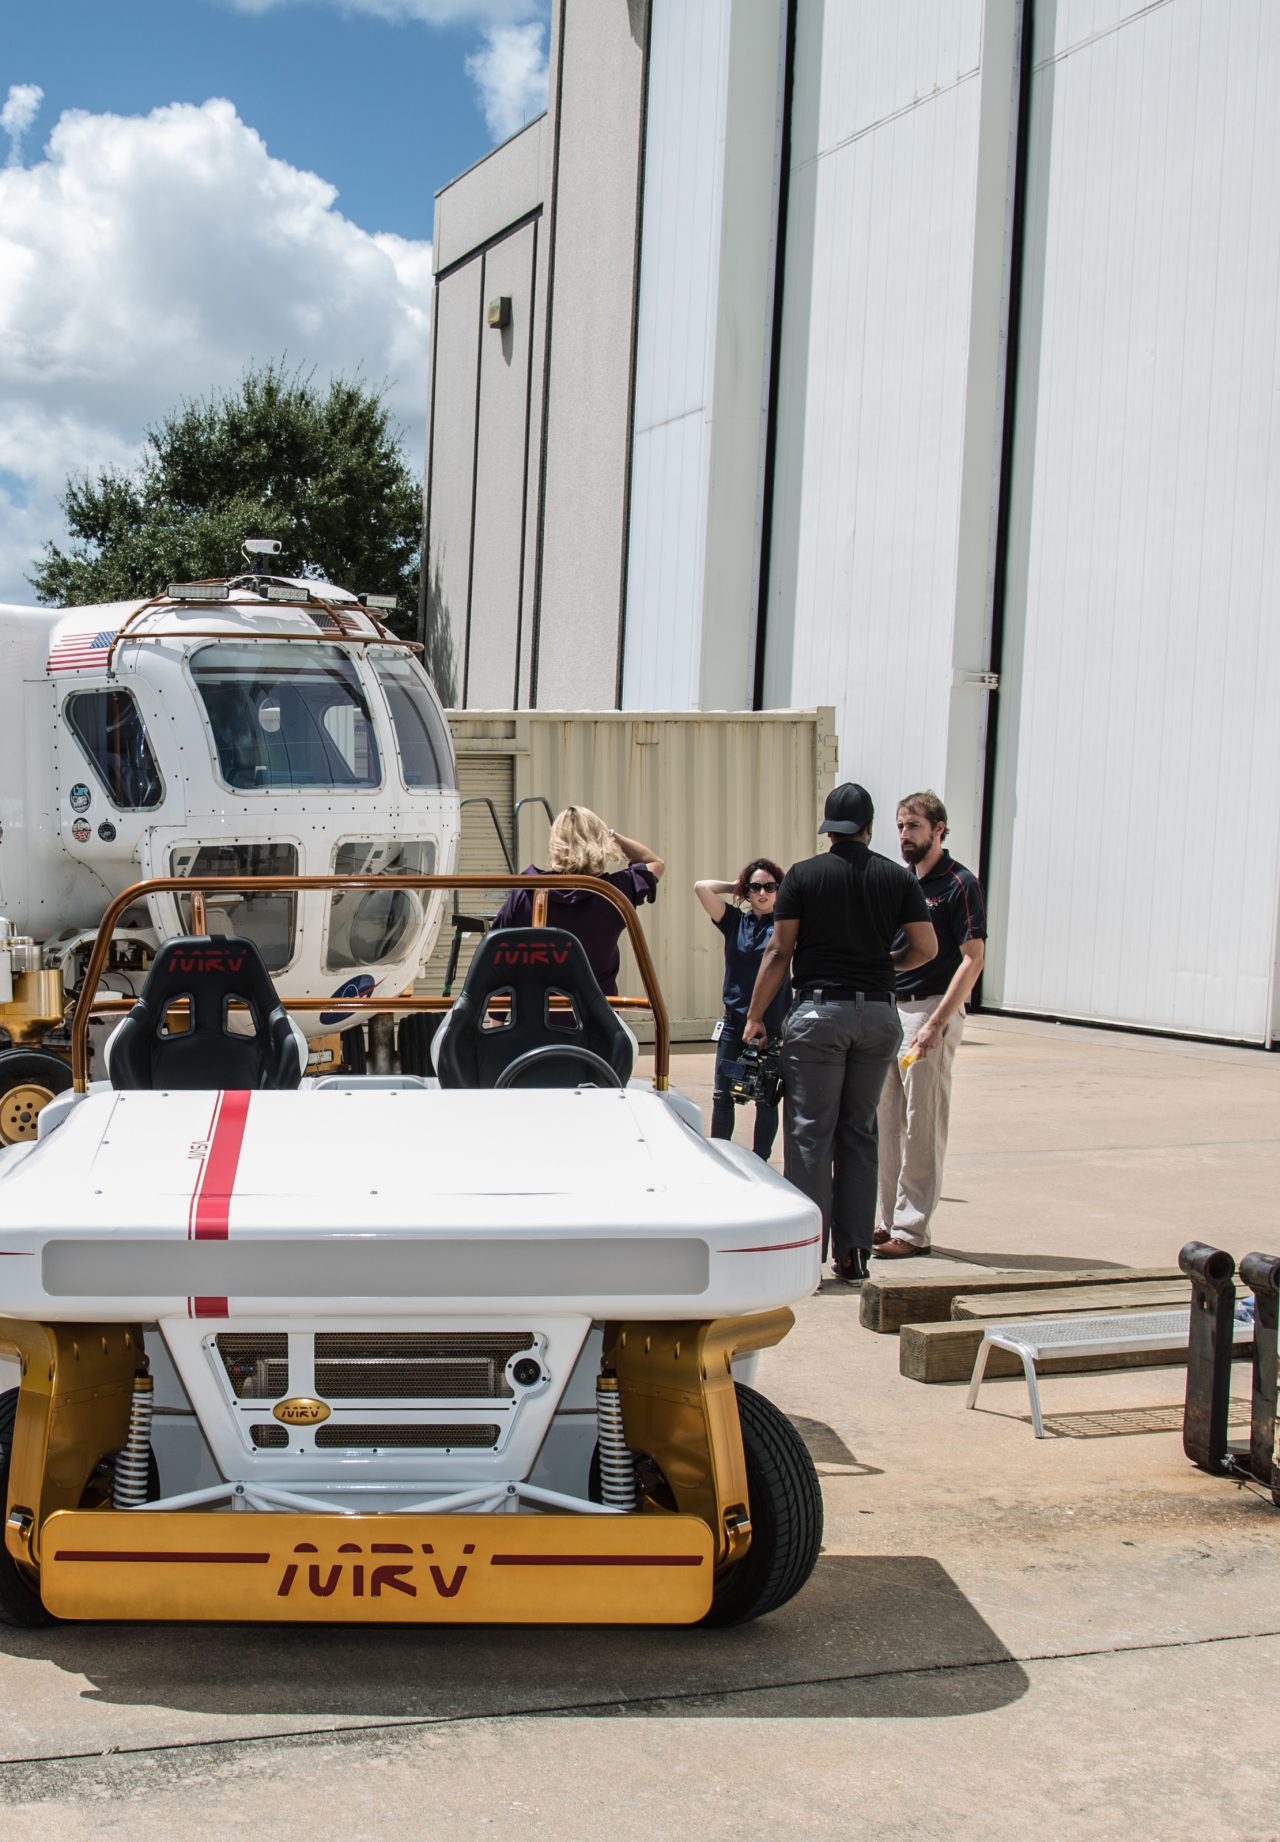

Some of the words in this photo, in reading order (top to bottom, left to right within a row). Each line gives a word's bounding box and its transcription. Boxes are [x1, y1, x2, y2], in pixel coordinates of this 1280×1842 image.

[168, 949, 248, 972] MRV
[494, 942, 573, 964] MRV
[281, 1406, 320, 1418] MRV
[277, 1543, 475, 1597] MRV
